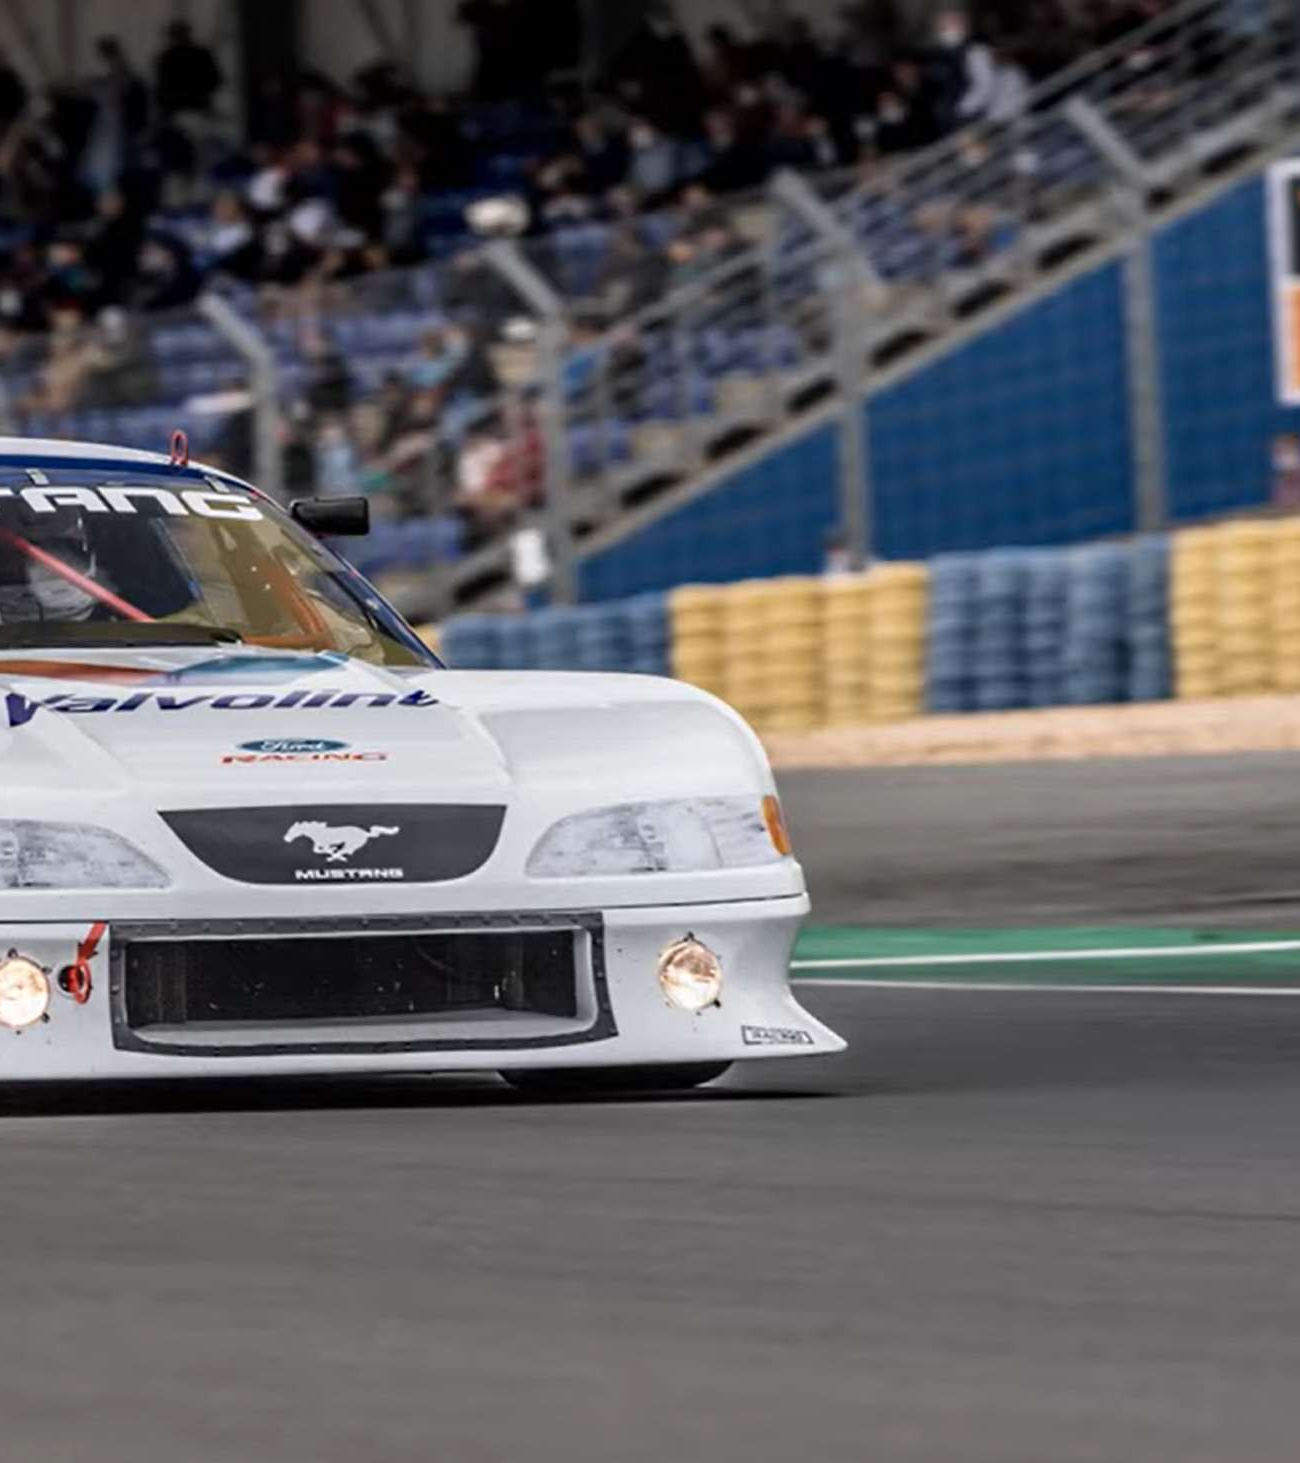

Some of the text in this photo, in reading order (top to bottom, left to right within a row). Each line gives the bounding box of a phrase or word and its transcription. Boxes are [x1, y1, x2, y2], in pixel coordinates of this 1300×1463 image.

[260, 740, 326, 752] Ford
[221, 751, 387, 764] RACING
[295, 867, 404, 881] MUSTANG
